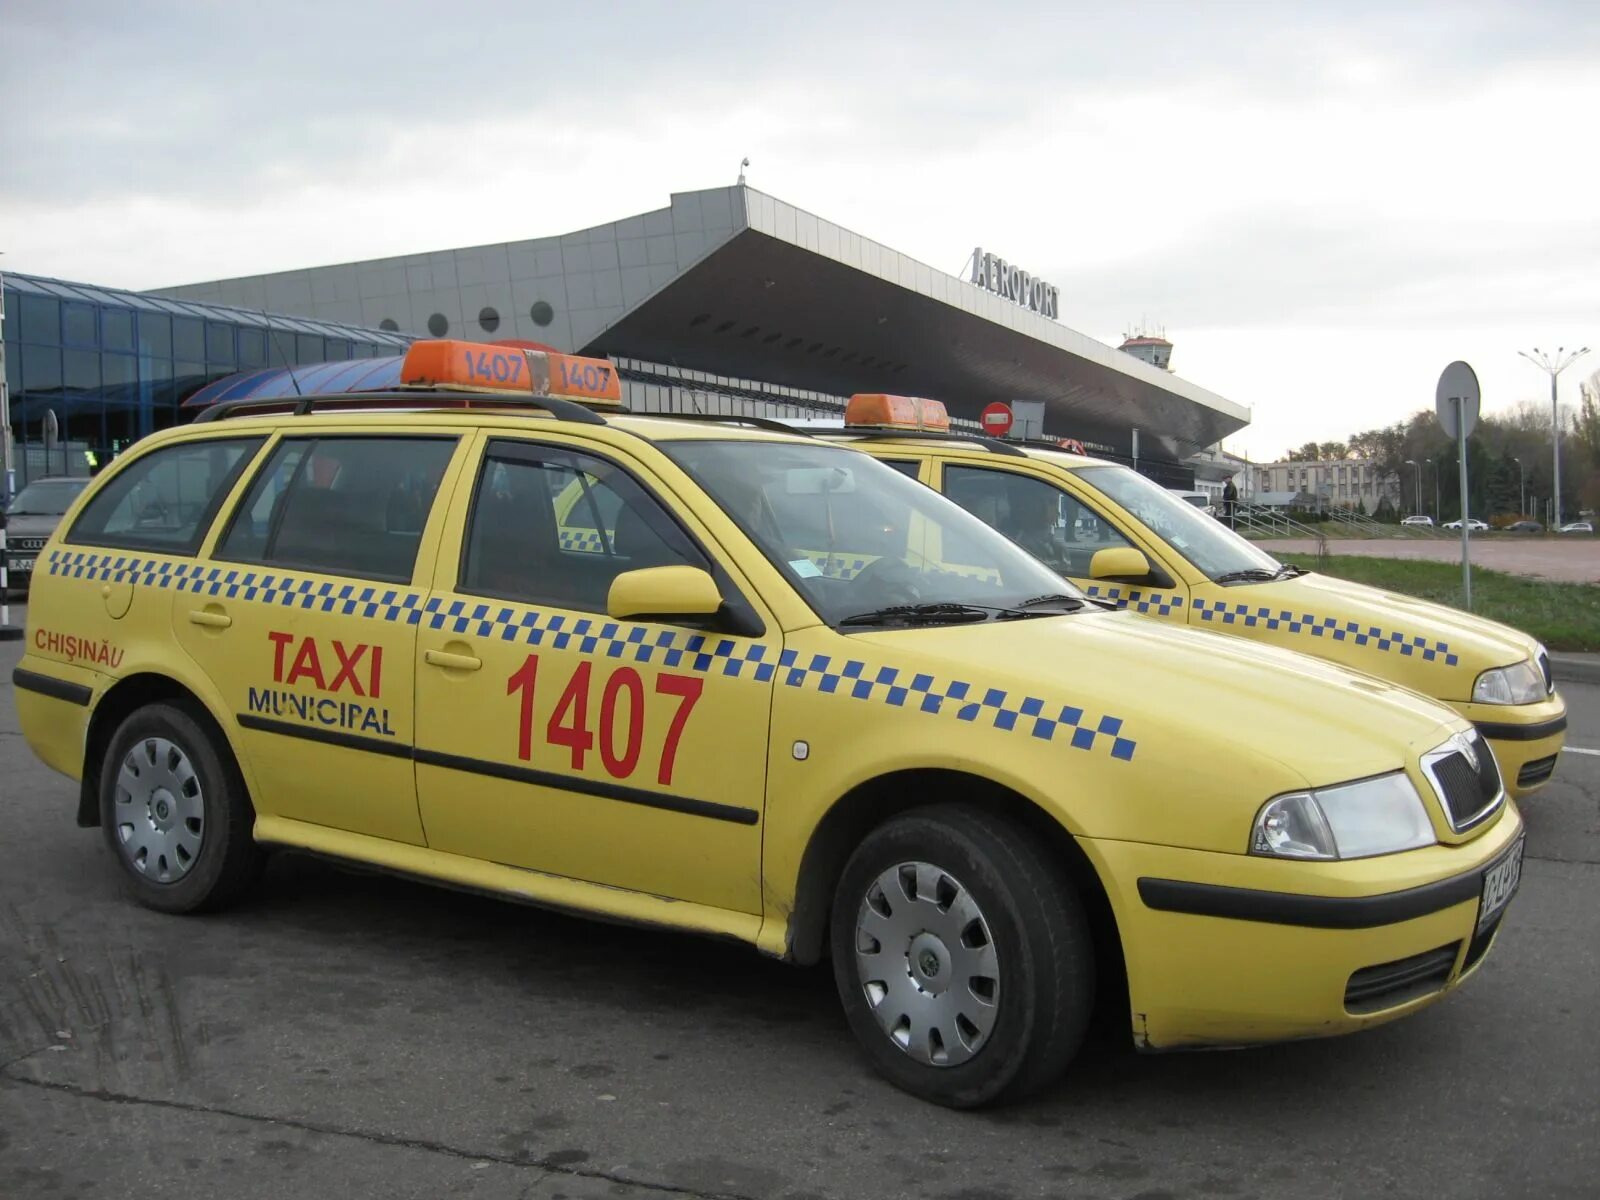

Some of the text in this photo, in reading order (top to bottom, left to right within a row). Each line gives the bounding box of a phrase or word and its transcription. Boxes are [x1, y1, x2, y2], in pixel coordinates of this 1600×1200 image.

[969, 247, 1060, 320] AEROPORT
[465, 351, 524, 383] 1407
[560, 361, 610, 392] 1407
[268, 631, 383, 698] TAXI
[249, 687, 395, 736] MUNICIPAL
[507, 654, 704, 785] 1407
